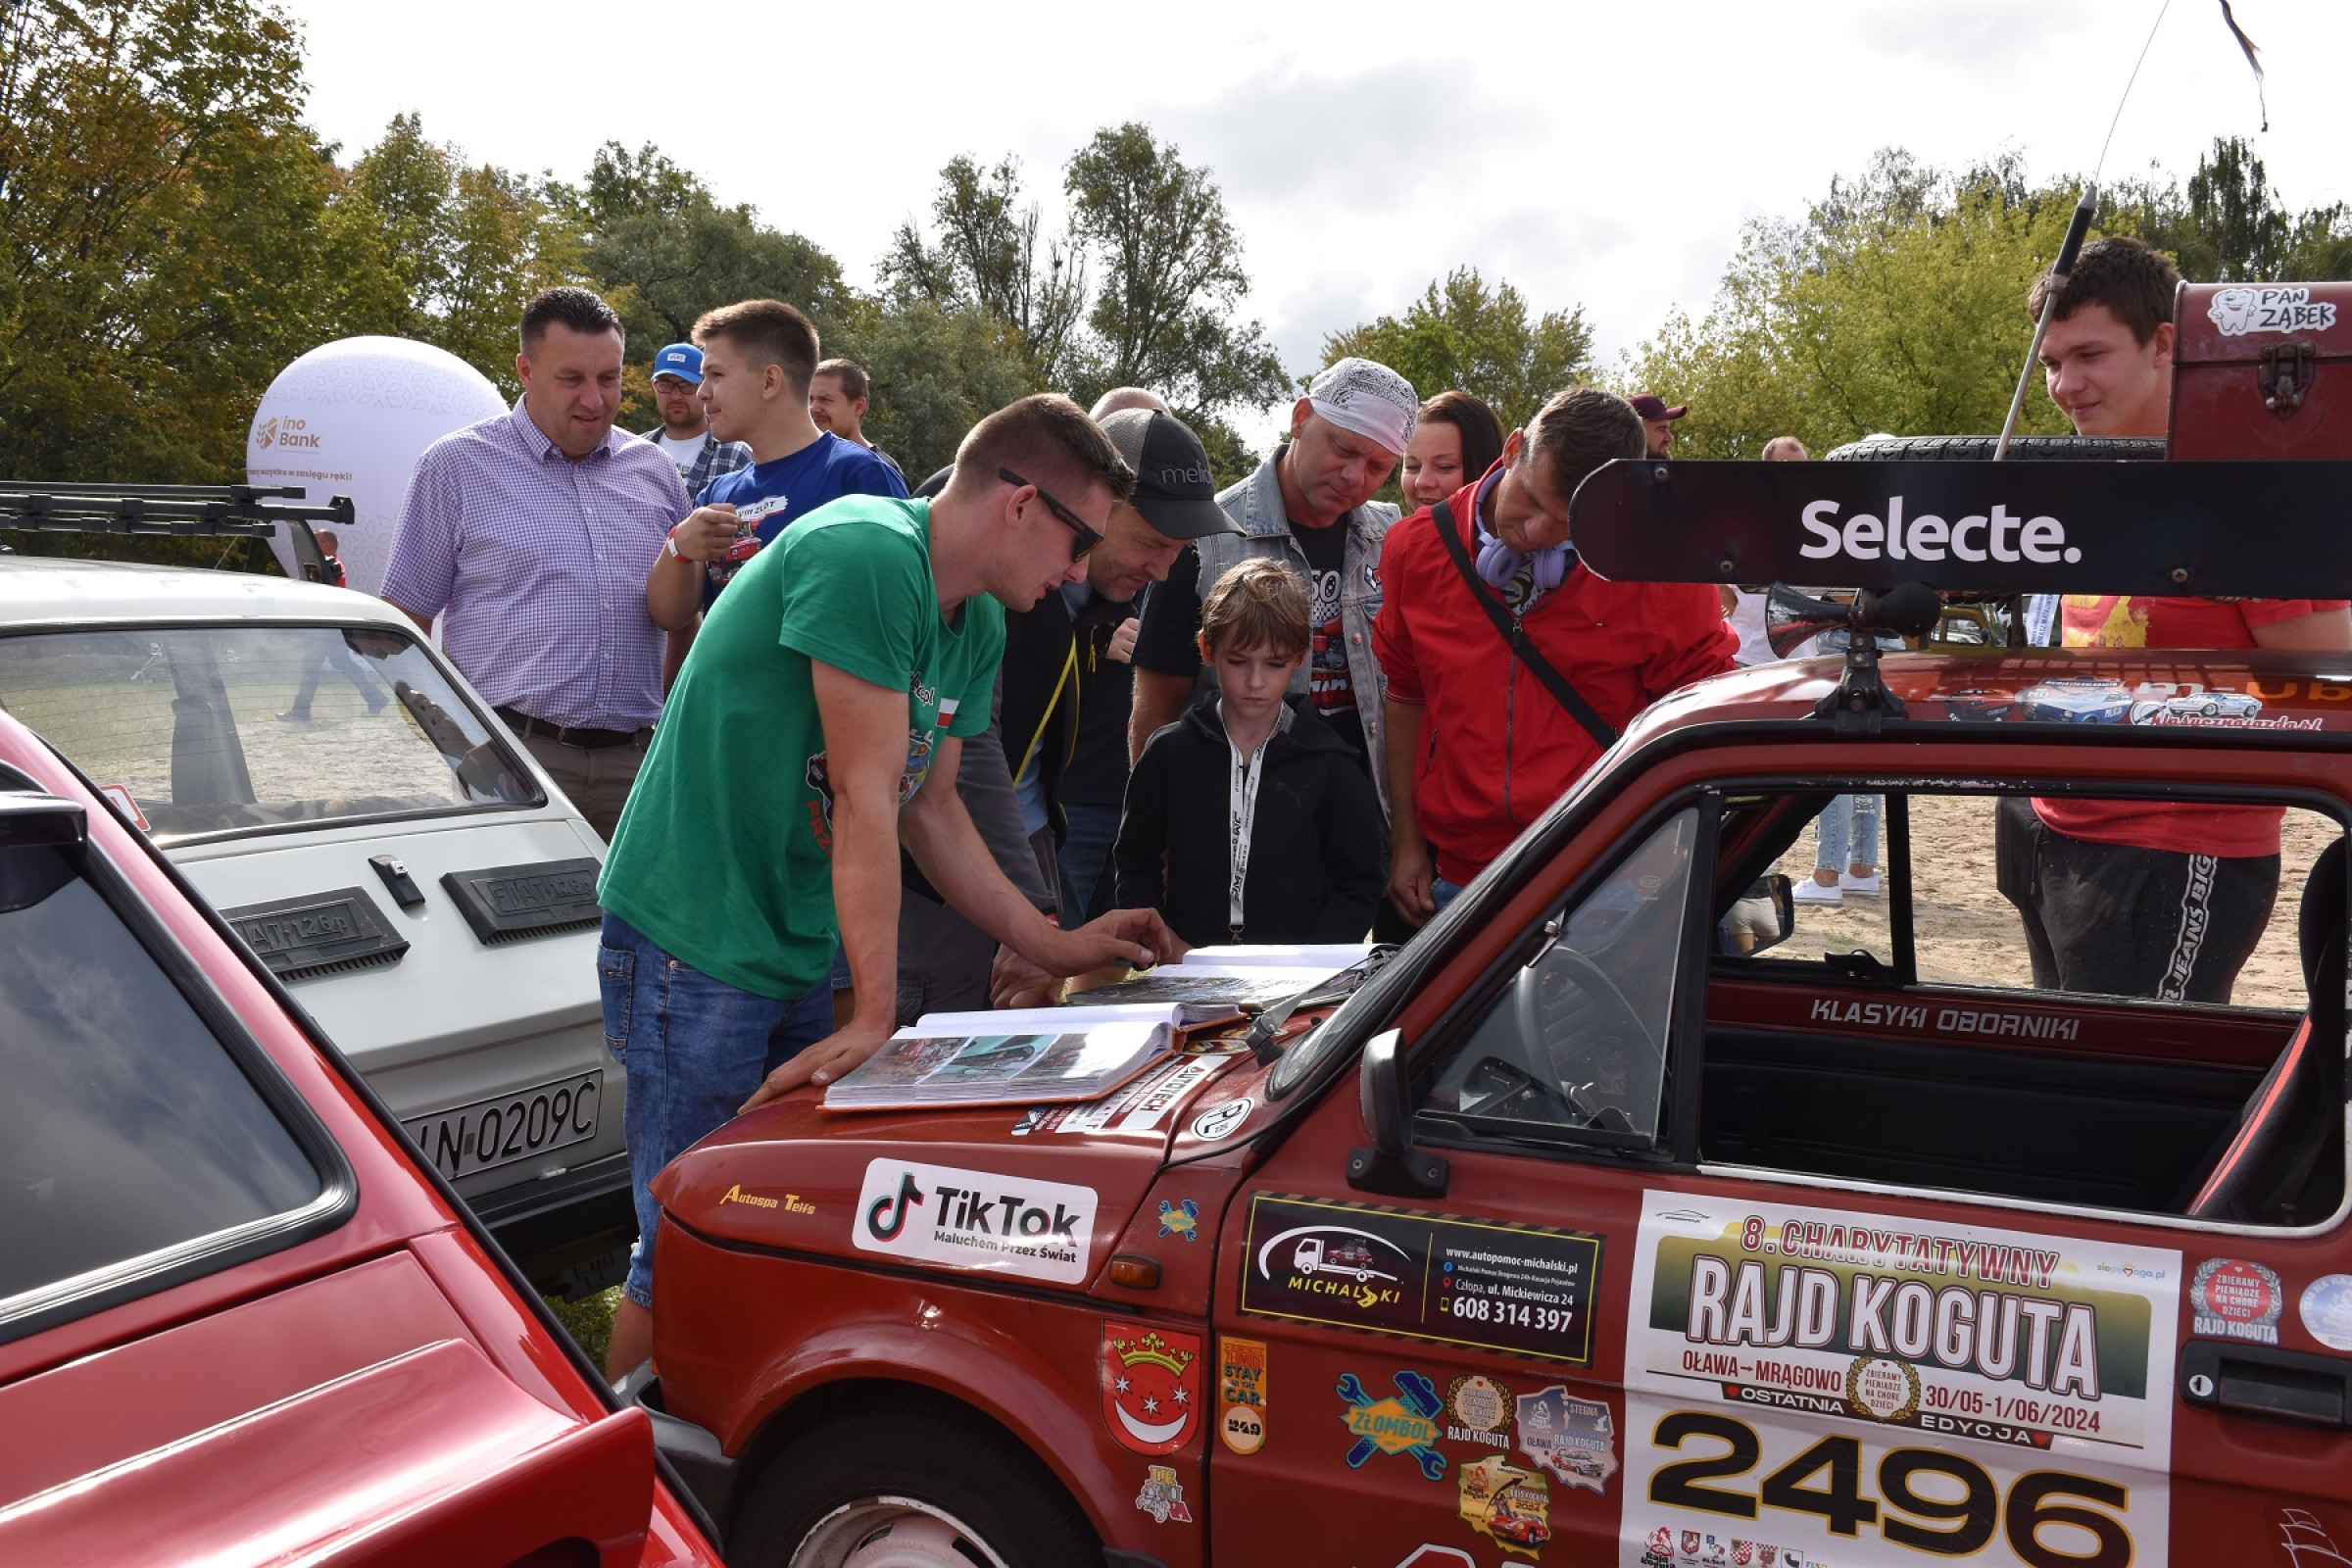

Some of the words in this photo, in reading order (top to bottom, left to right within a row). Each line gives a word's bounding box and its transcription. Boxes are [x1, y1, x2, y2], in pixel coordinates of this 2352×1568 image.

[2261, 289, 2305, 305] PAN
[2259, 306, 2332, 329] ZĄBEK
[282, 416, 307, 430] ino
[279, 432, 320, 448] Bank
[1799, 495, 2082, 564] Selecte.
[1810, 999, 1929, 1028] KLASYKI
[1936, 1009, 2080, 1041] OBORNIKI
[719, 1184, 779, 1208] Autospa
[936, 1186, 1082, 1249] TikTok
[933, 1230, 998, 1252] Maluchem
[1001, 1240, 1037, 1258] Przez
[1039, 1245, 1077, 1263] Świat
[1446, 1247, 1579, 1274] www.autopomoc-michalski.pl
[2215, 1285, 2261, 1299] PIENIĄDZE
[2216, 1274, 2261, 1289] ZBIERAMY
[1488, 1284, 1500, 1296] ul.
[1501, 1286, 1560, 1303] Mickiewicza
[1560, 1294, 1574, 1306] 24
[2215, 1294, 2228, 1304] NA
[2230, 1296, 2259, 1307] CHORE
[1453, 1296, 1491, 1321] 608
[1493, 1300, 1531, 1327] 314
[1535, 1306, 1574, 1334] 397
[2222, 1306, 2251, 1318] DZIECI
[1685, 1252, 1841, 1348] RAJD
[1847, 1273, 2102, 1402] KOGUTA
[2193, 1316, 2226, 1335] RAJD
[2227, 1320, 2279, 1346] KOGUTA
[1224, 1363, 1262, 1382] STAY
[1682, 1349, 1740, 1378] OŁAWA
[1754, 1359, 1842, 1393] MRĄGOWO
[1866, 1369, 1902, 1382] ZBIERAMY
[1224, 1387, 1261, 1406] CAR
[1865, 1379, 1902, 1392] PIENIĄDZE
[1865, 1388, 1875, 1397] NA
[1877, 1391, 1901, 1401] CHORE
[1569, 1402, 1599, 1417] STEGNA
[1740, 1386, 1844, 1414] OSTATNIA
[1870, 1398, 1894, 1409] DZIECI
[1925, 1385, 2102, 1433] 30/05-1/06/2024
[1228, 1418, 1262, 1436] 249
[1353, 1409, 1431, 1442] ZŁOMBOL
[1920, 1415, 2032, 1446] EDYCJA
[1446, 1426, 1471, 1441] RAJD
[1473, 1430, 1510, 1450] KOGUTA
[1554, 1434, 1575, 1446] RAJD
[1575, 1438, 1606, 1452] KOGUTA
[1647, 1409, 2134, 1568] 2496
